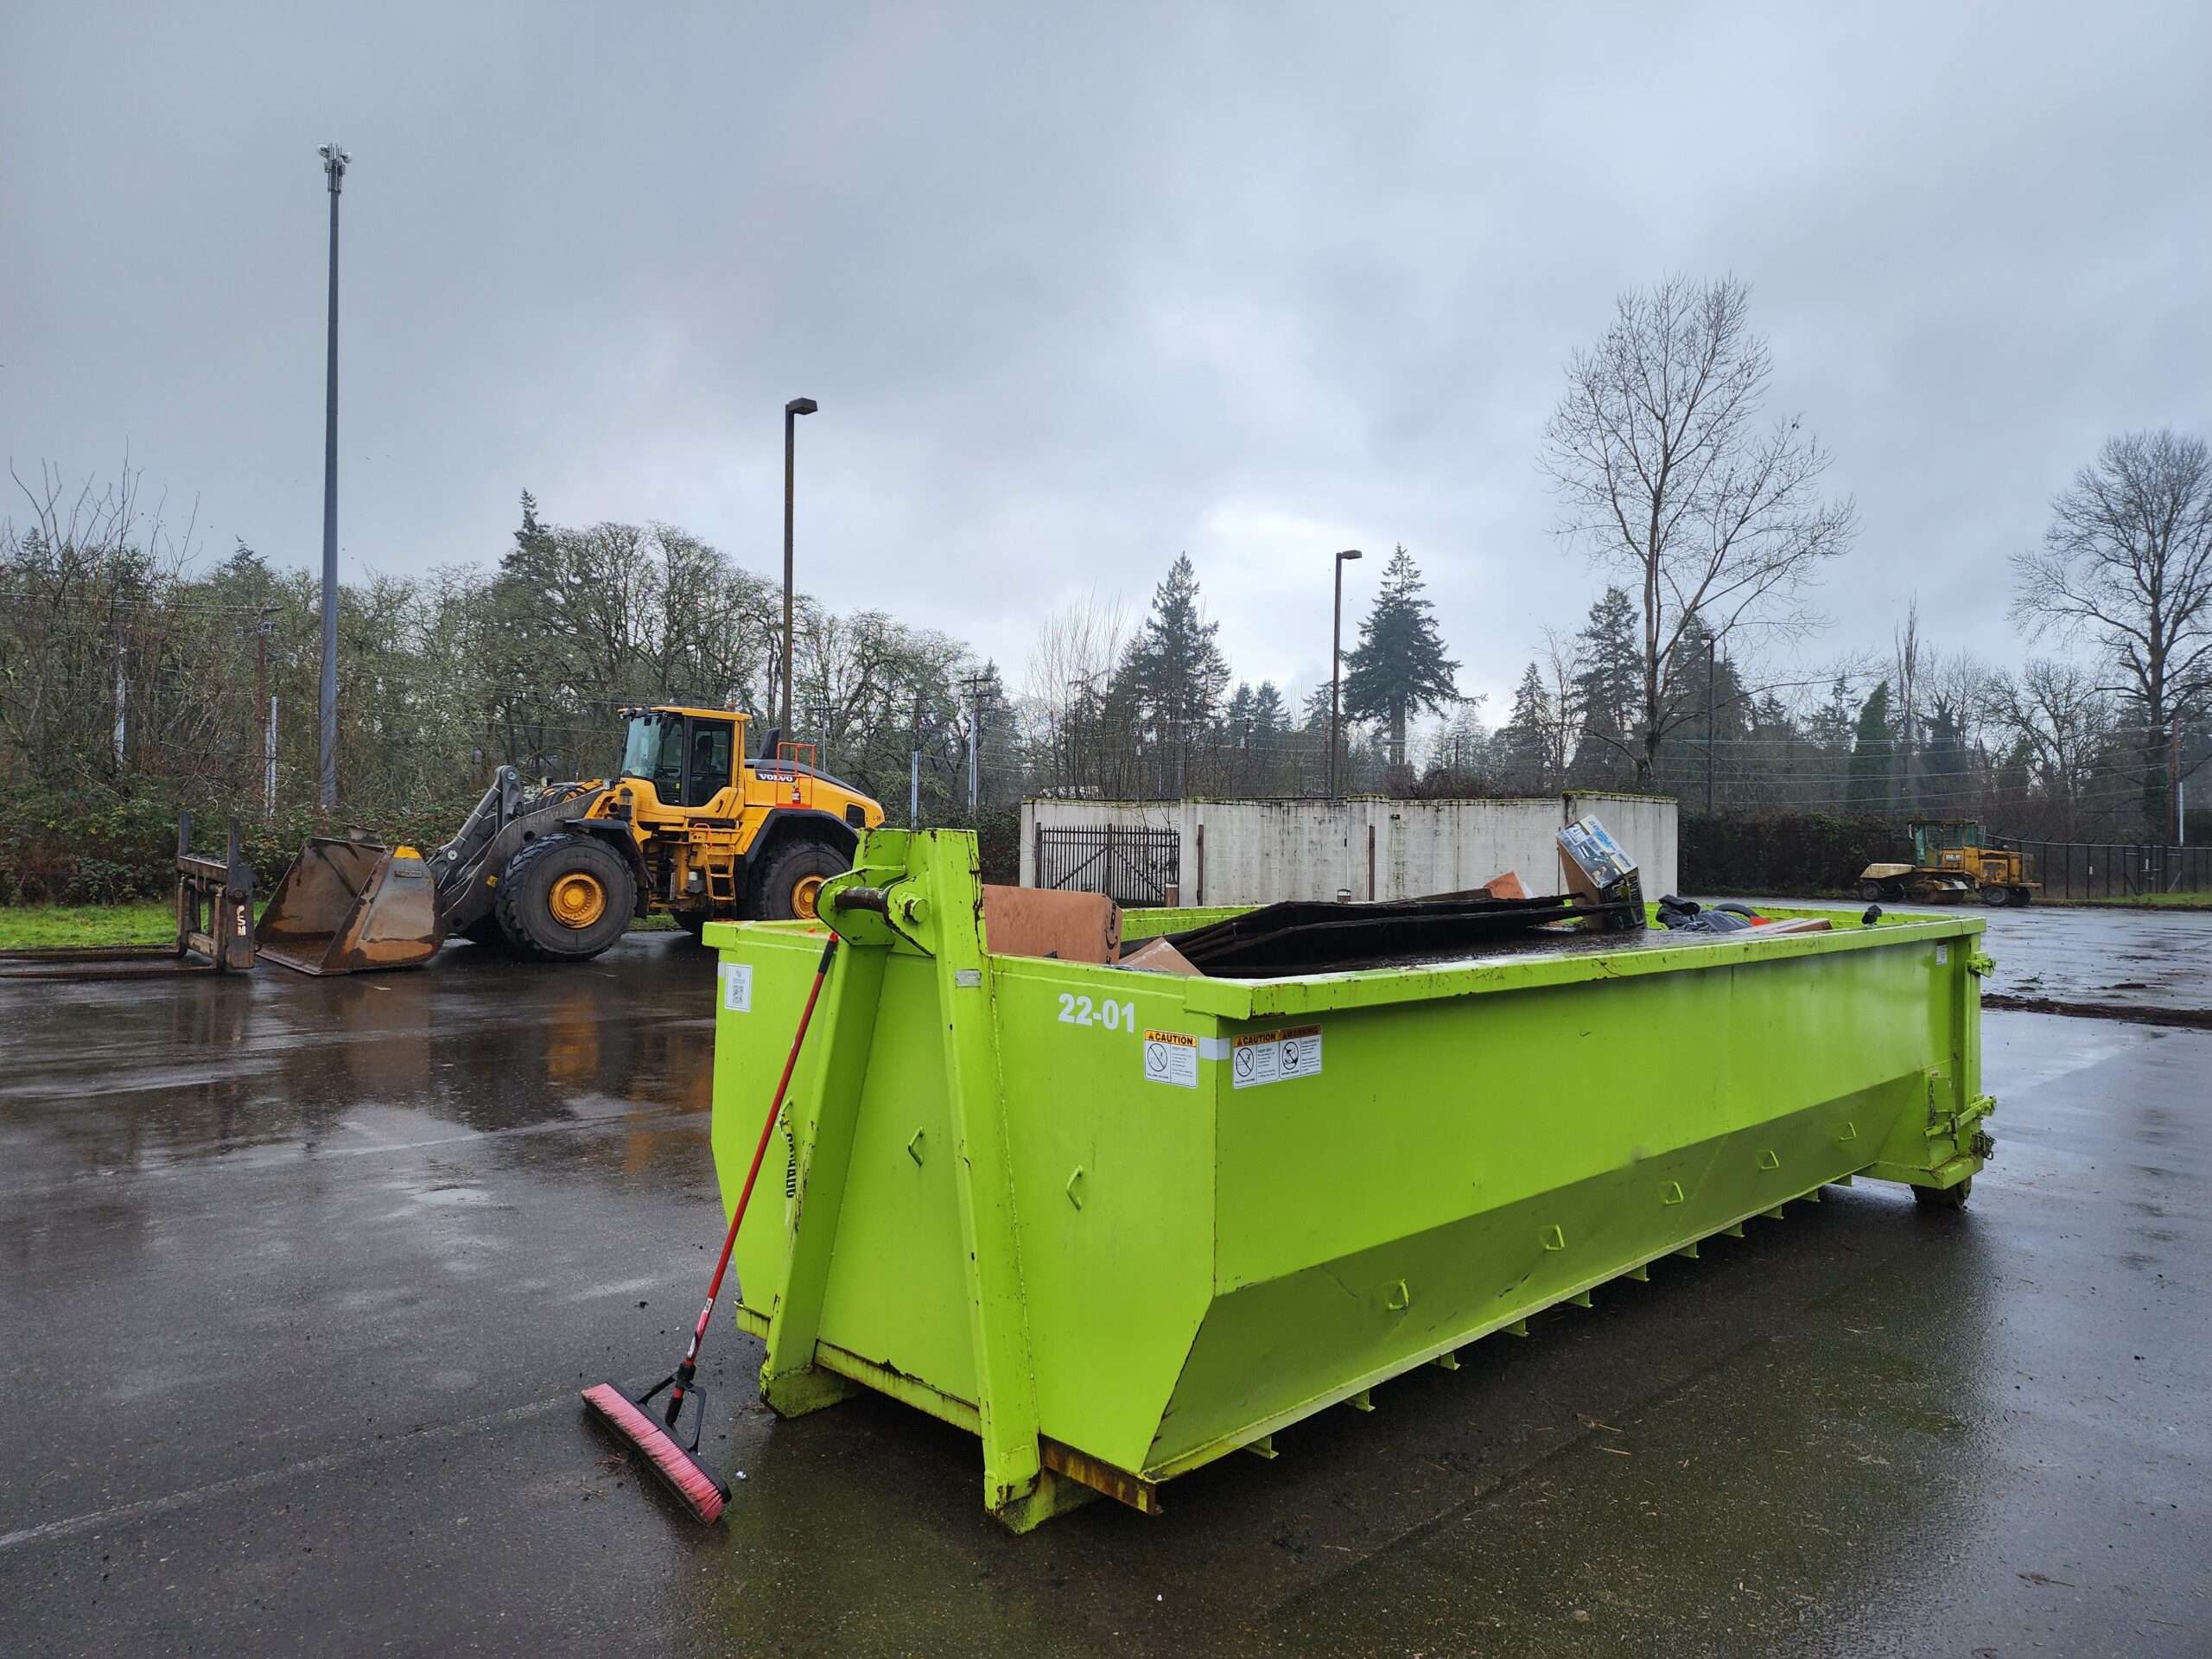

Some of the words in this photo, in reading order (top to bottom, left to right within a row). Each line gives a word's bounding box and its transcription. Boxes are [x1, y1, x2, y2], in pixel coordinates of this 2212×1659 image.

[759, 773, 793, 782] VOLVO
[1058, 993, 1135, 1033] 22-01
[1154, 1033, 1193, 1045] CAUTION
[1243, 1032, 1276, 1044] CAUTION
